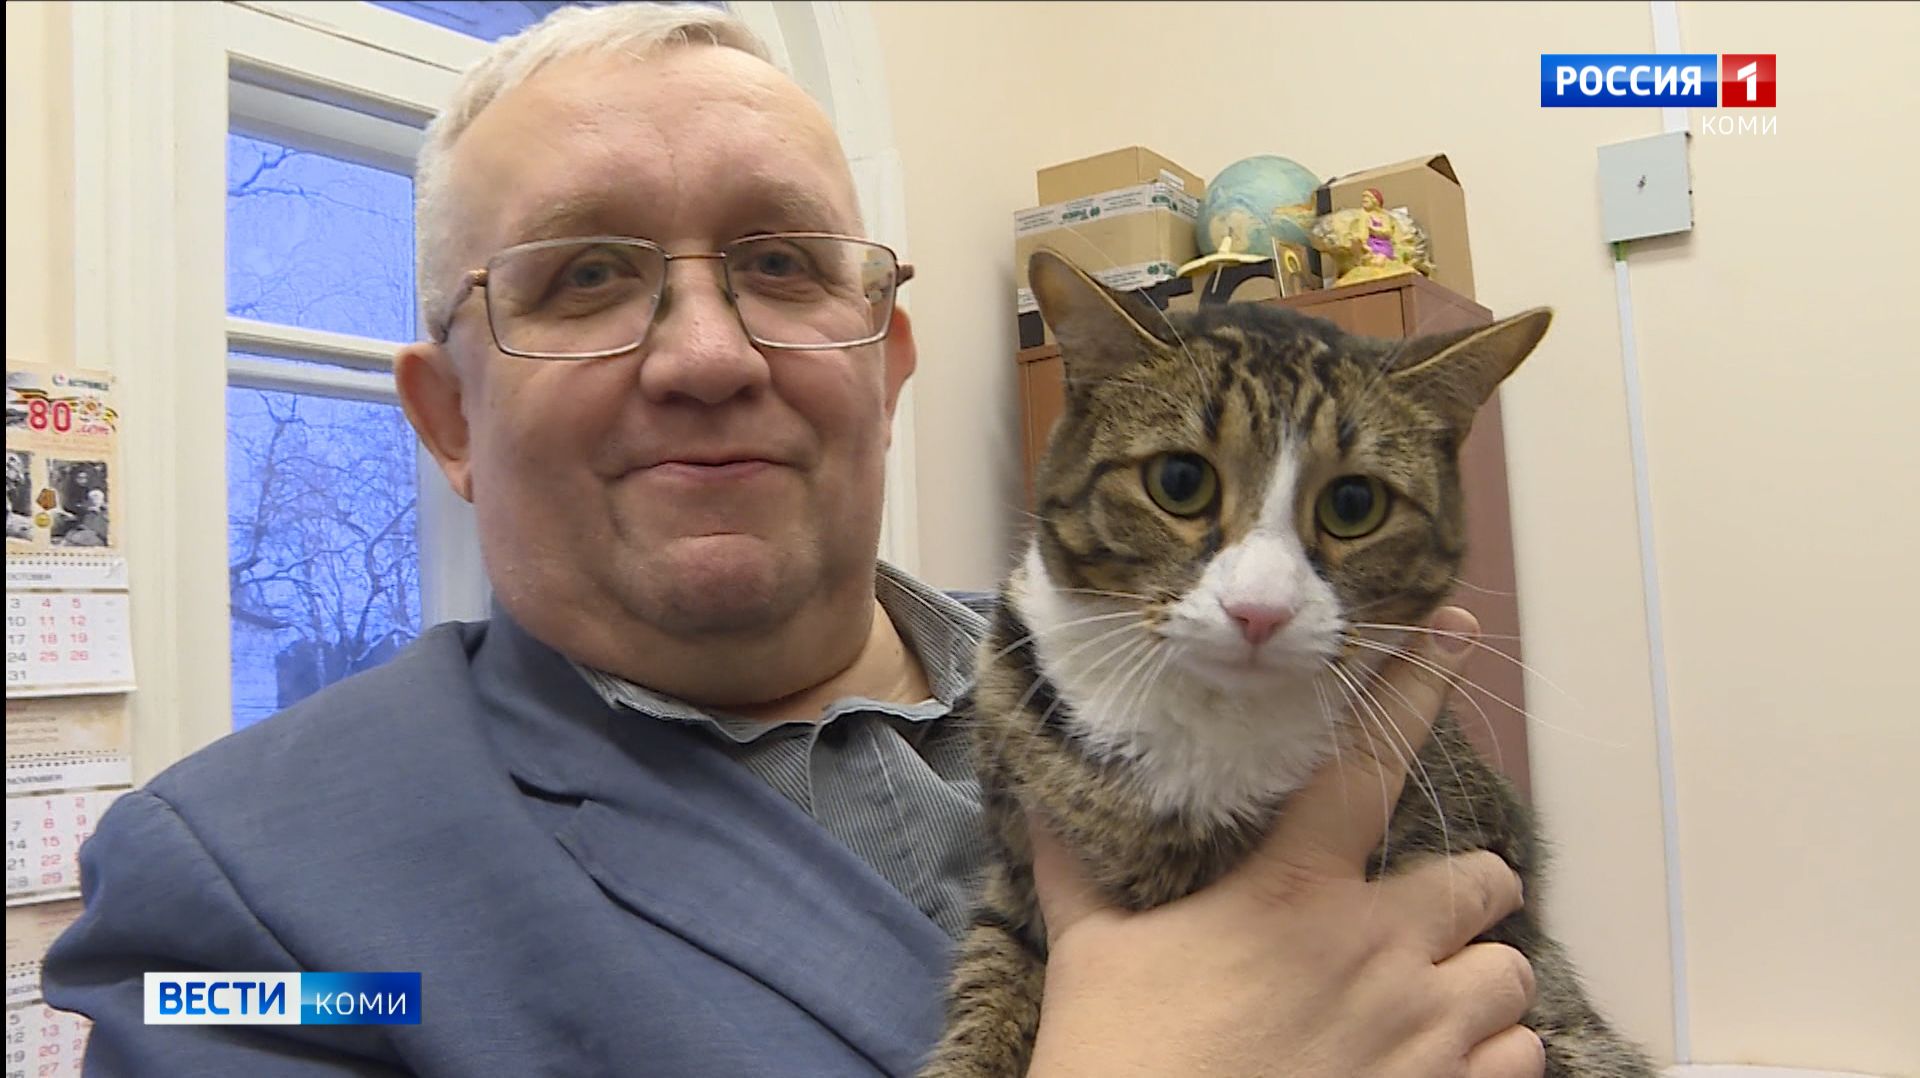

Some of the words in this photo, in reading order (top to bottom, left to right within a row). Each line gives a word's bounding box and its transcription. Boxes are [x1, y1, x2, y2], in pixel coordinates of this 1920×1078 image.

[29, 400, 72, 433] 80
[10, 598, 21, 609] 3
[42, 598, 51, 608] 4
[72, 598, 81, 609] 5
[8, 616, 26, 627] 10
[40, 616, 55, 626] 11
[70, 615, 86, 626] 12
[8, 634, 26, 645] 17
[40, 633, 57, 645] 18
[70, 632, 88, 643] 19
[8, 652, 27, 663] 24
[39, 651, 58, 662] 25
[70, 651, 88, 661] 26
[8, 670, 26, 681] 31
[45, 800, 52, 811] 1
[75, 797, 85, 809] 2
[8, 840, 27, 851] 14
[42, 836, 60, 847] 15
[8, 858, 25, 871] 21
[41, 854, 61, 867] 22
[42, 872, 62, 885] 29
[9, 1014, 20, 1026] 5
[7, 1032, 25, 1044] 12
[40, 1024, 59, 1037] 13
[7, 1050, 26, 1063] 19
[39, 1044, 60, 1057] 20
[39, 1062, 60, 1077] 27
